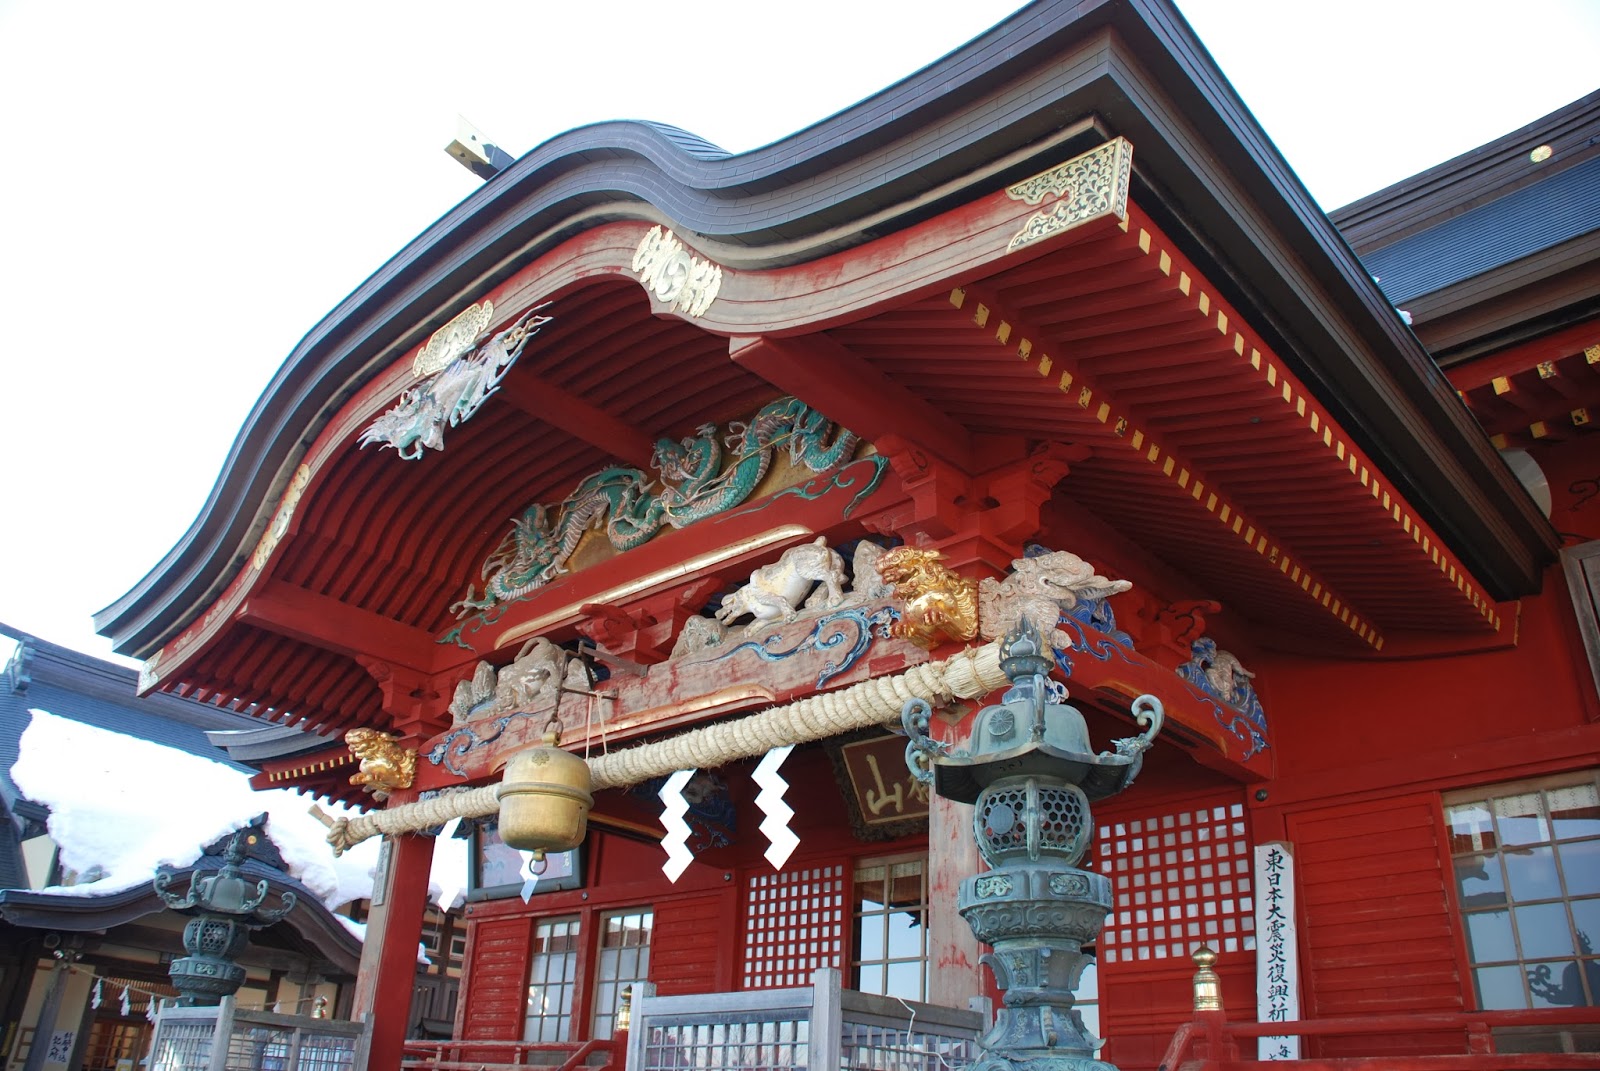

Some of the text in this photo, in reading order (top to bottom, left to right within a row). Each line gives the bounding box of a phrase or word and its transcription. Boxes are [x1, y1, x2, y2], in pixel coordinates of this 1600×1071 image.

[1264, 849, 1289, 1039] 東日本大震災復興祈
